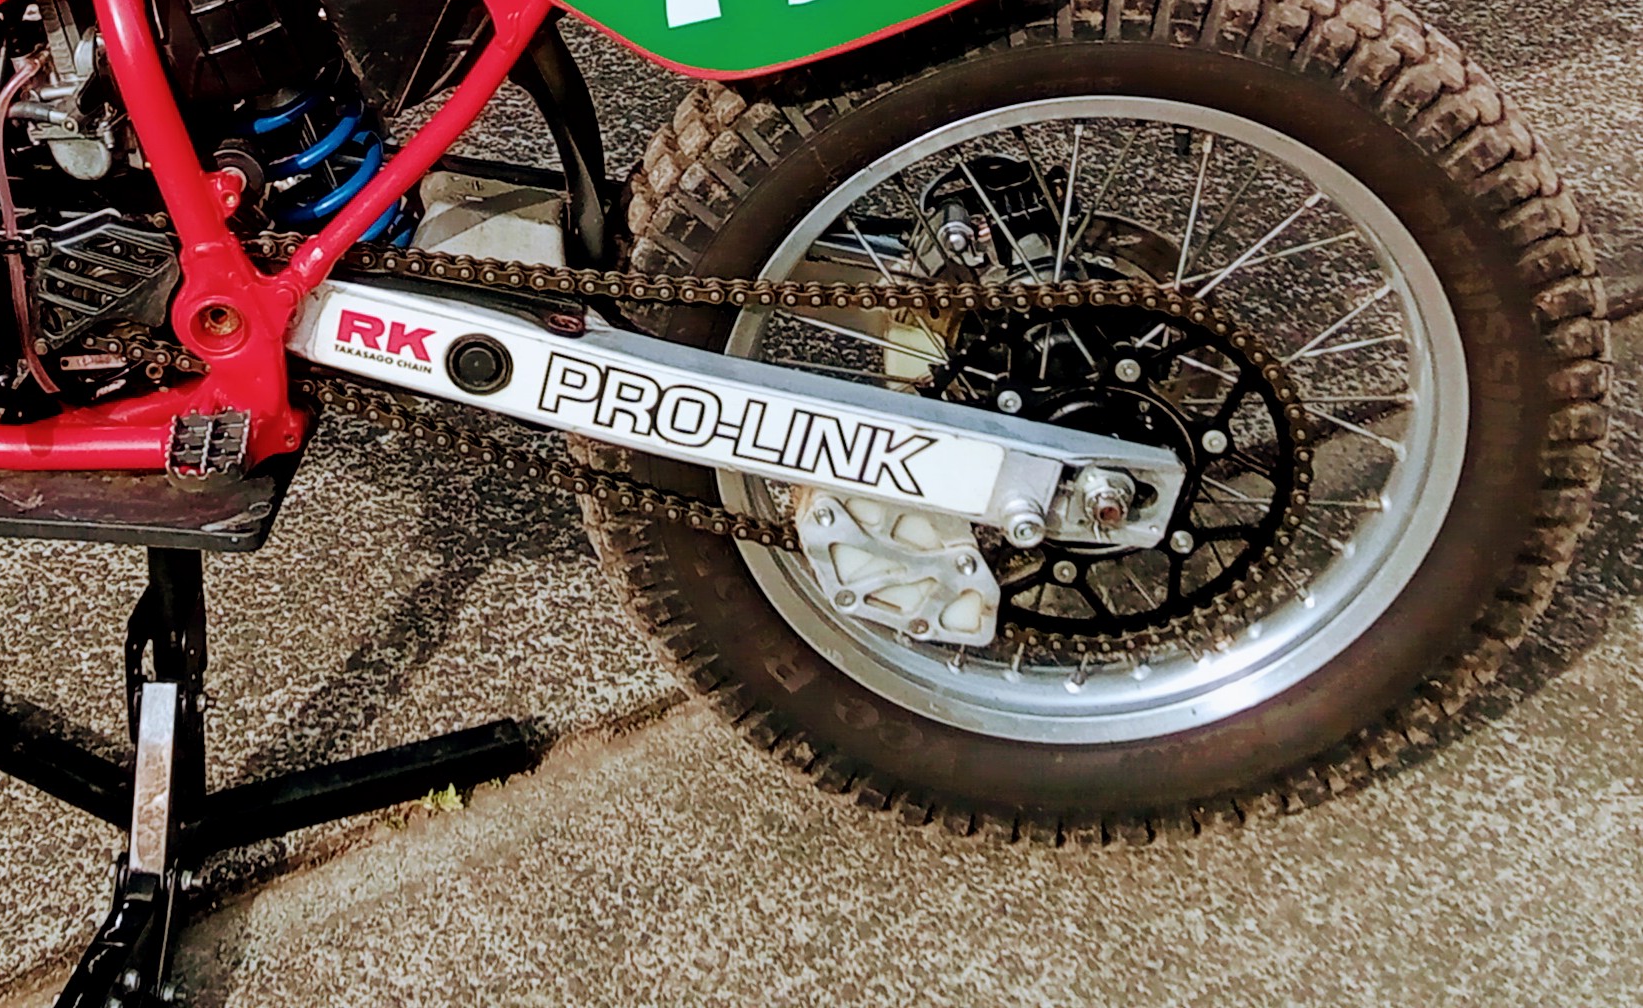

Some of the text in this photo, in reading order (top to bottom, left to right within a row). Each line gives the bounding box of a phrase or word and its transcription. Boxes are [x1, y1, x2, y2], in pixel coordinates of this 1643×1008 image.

[334, 344, 433, 374] TAKASAGO CHAIN
[336, 309, 436, 363] RK
[538, 352, 939, 497] PRO-LINK
